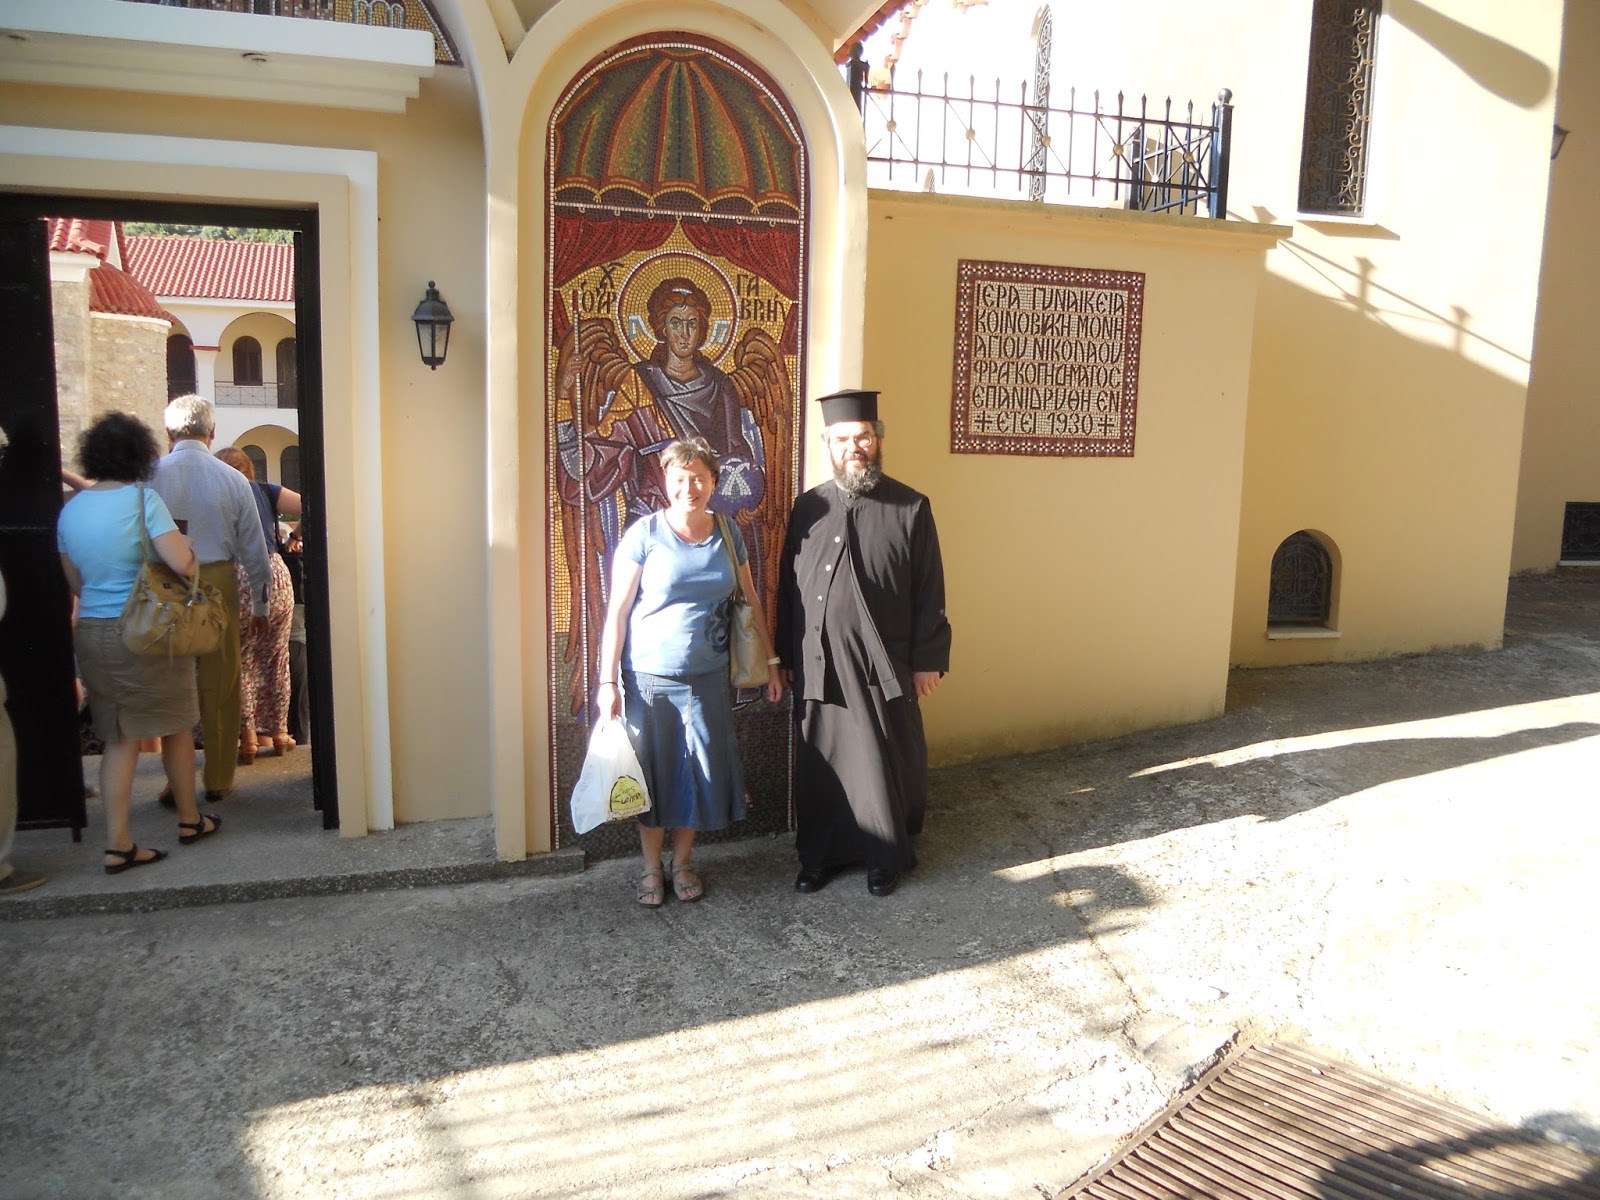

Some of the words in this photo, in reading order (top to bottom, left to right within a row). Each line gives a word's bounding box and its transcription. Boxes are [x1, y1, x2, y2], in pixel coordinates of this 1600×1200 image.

[976, 283, 1020, 308] ΙΕΡΑ
[1033, 287, 1124, 315] ΓΥΝΑΙΚΕΙΑ
[1077, 315, 1124, 340] ΜΟΝΗ
[974, 335, 1027, 359] ΑΓΙΟΥ
[1033, 337, 1122, 364] ΝΙΚΟΛΑΟΥ
[1097, 390, 1119, 412] ΕΝ
[997, 411, 1037, 434] ΕΤΕΙ
[1047, 412, 1093, 435] 1930
